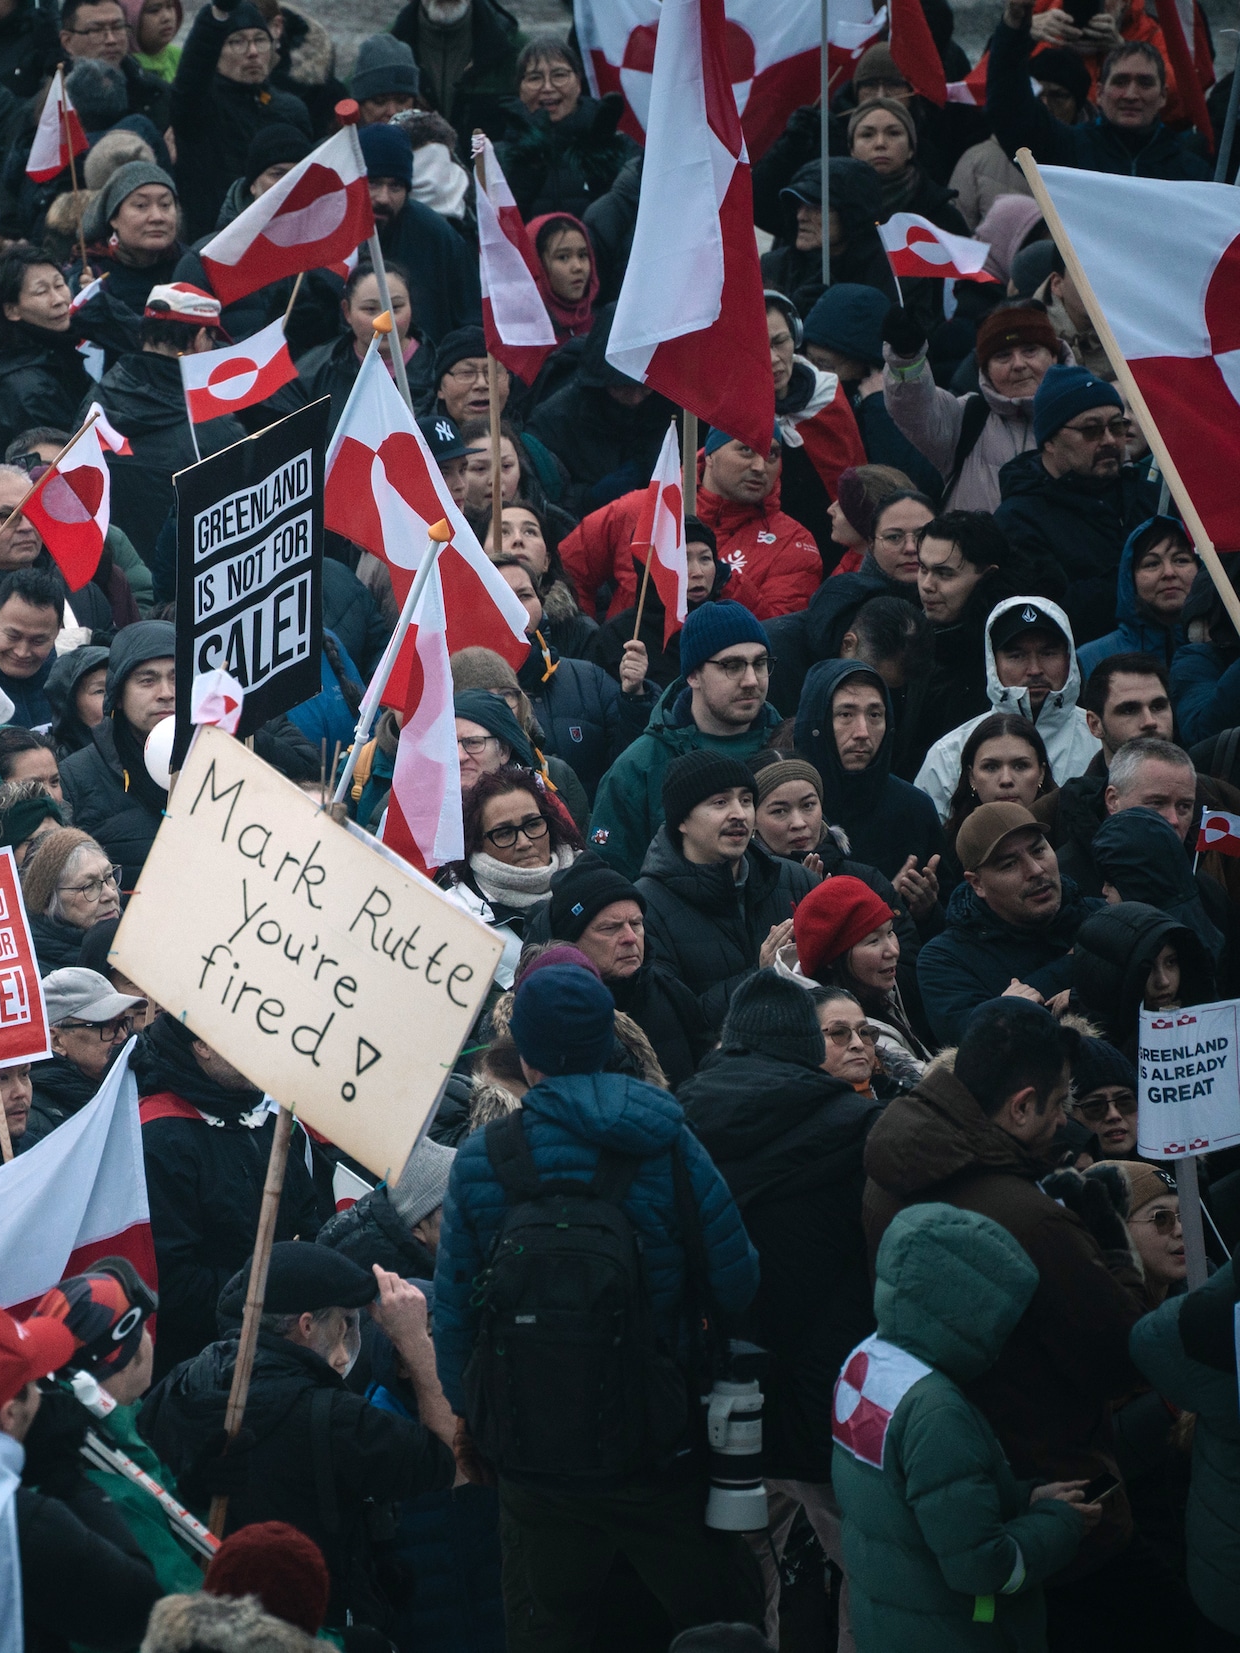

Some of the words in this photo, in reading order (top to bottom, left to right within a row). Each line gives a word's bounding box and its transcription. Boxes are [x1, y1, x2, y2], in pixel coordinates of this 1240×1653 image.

[198, 458, 308, 554] GREENLAND
[198, 574, 215, 617] IS
[227, 546, 266, 601] NOT
[273, 519, 308, 572] FOR
[198, 578, 308, 689] SALE!
[190, 758, 326, 911] Mark
[349, 885, 474, 1008] Rutte
[198, 944, 382, 1102] fired!
[1151, 1055, 1227, 1081] ALREADY
[1147, 1077, 1215, 1104] GREAT
